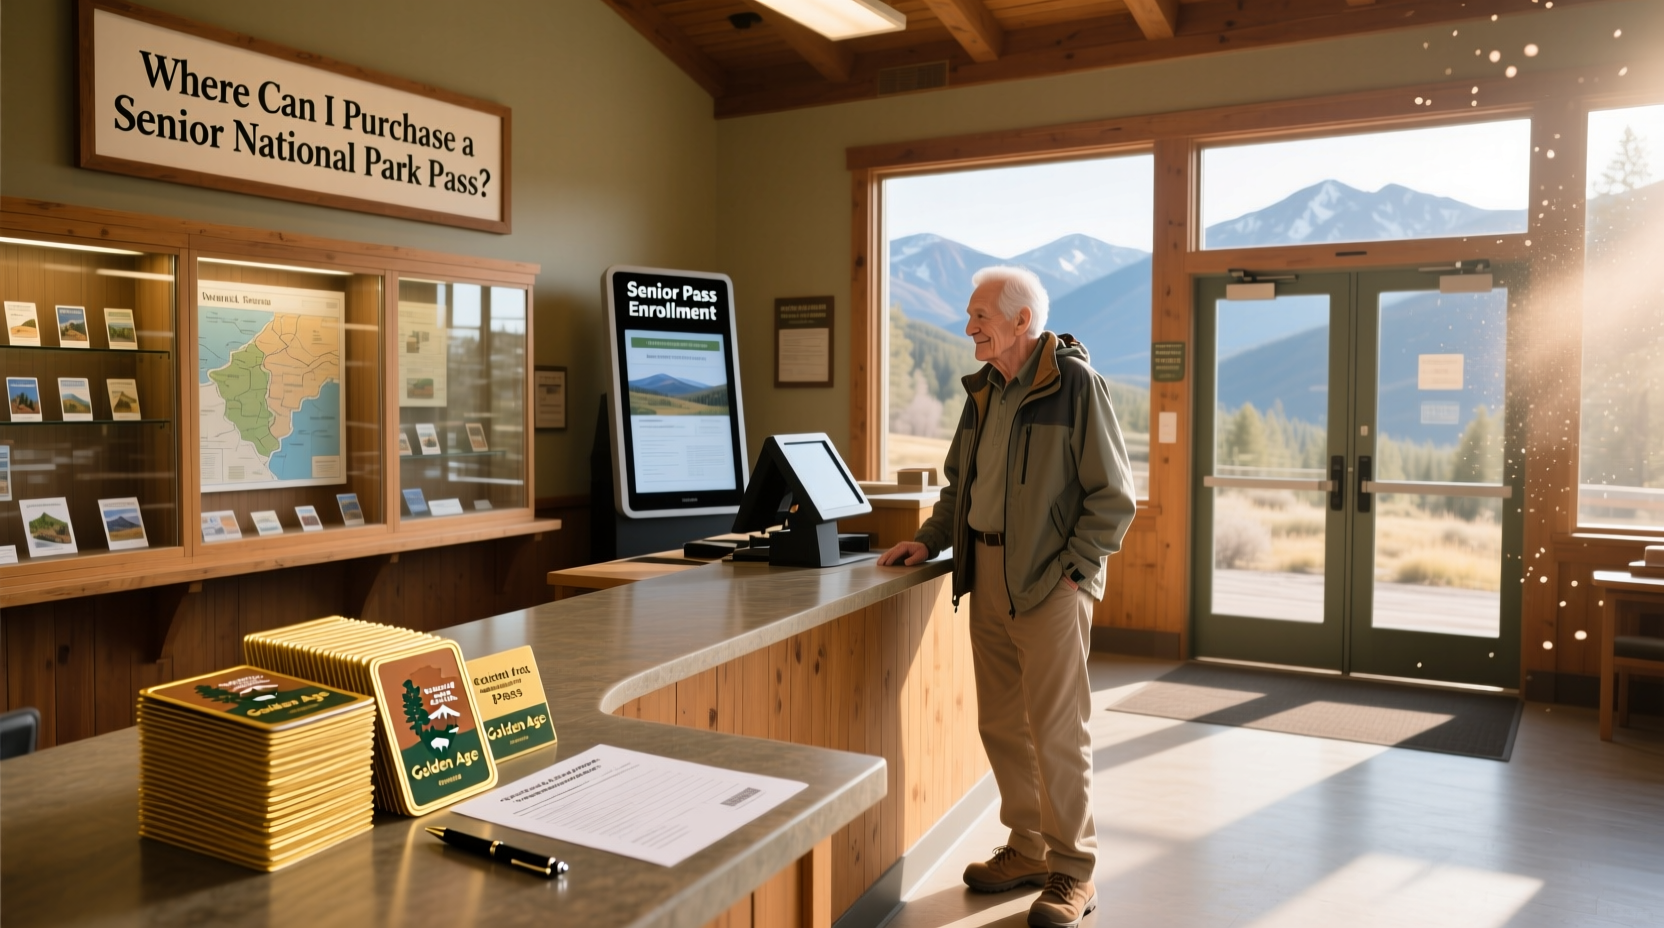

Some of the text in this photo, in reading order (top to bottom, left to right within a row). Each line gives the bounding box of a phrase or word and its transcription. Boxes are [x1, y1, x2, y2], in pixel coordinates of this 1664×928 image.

[139, 50, 475, 157] Where Can I Purchase a
[114, 95, 491, 198] Senior National Park Pass?
[627, 280, 718, 303] Senior Pass
[629, 300, 717, 321] Enrollment
[527, 714, 547, 729] Age
[411, 758, 454, 780] Golden
[456, 749, 479, 767] Age
